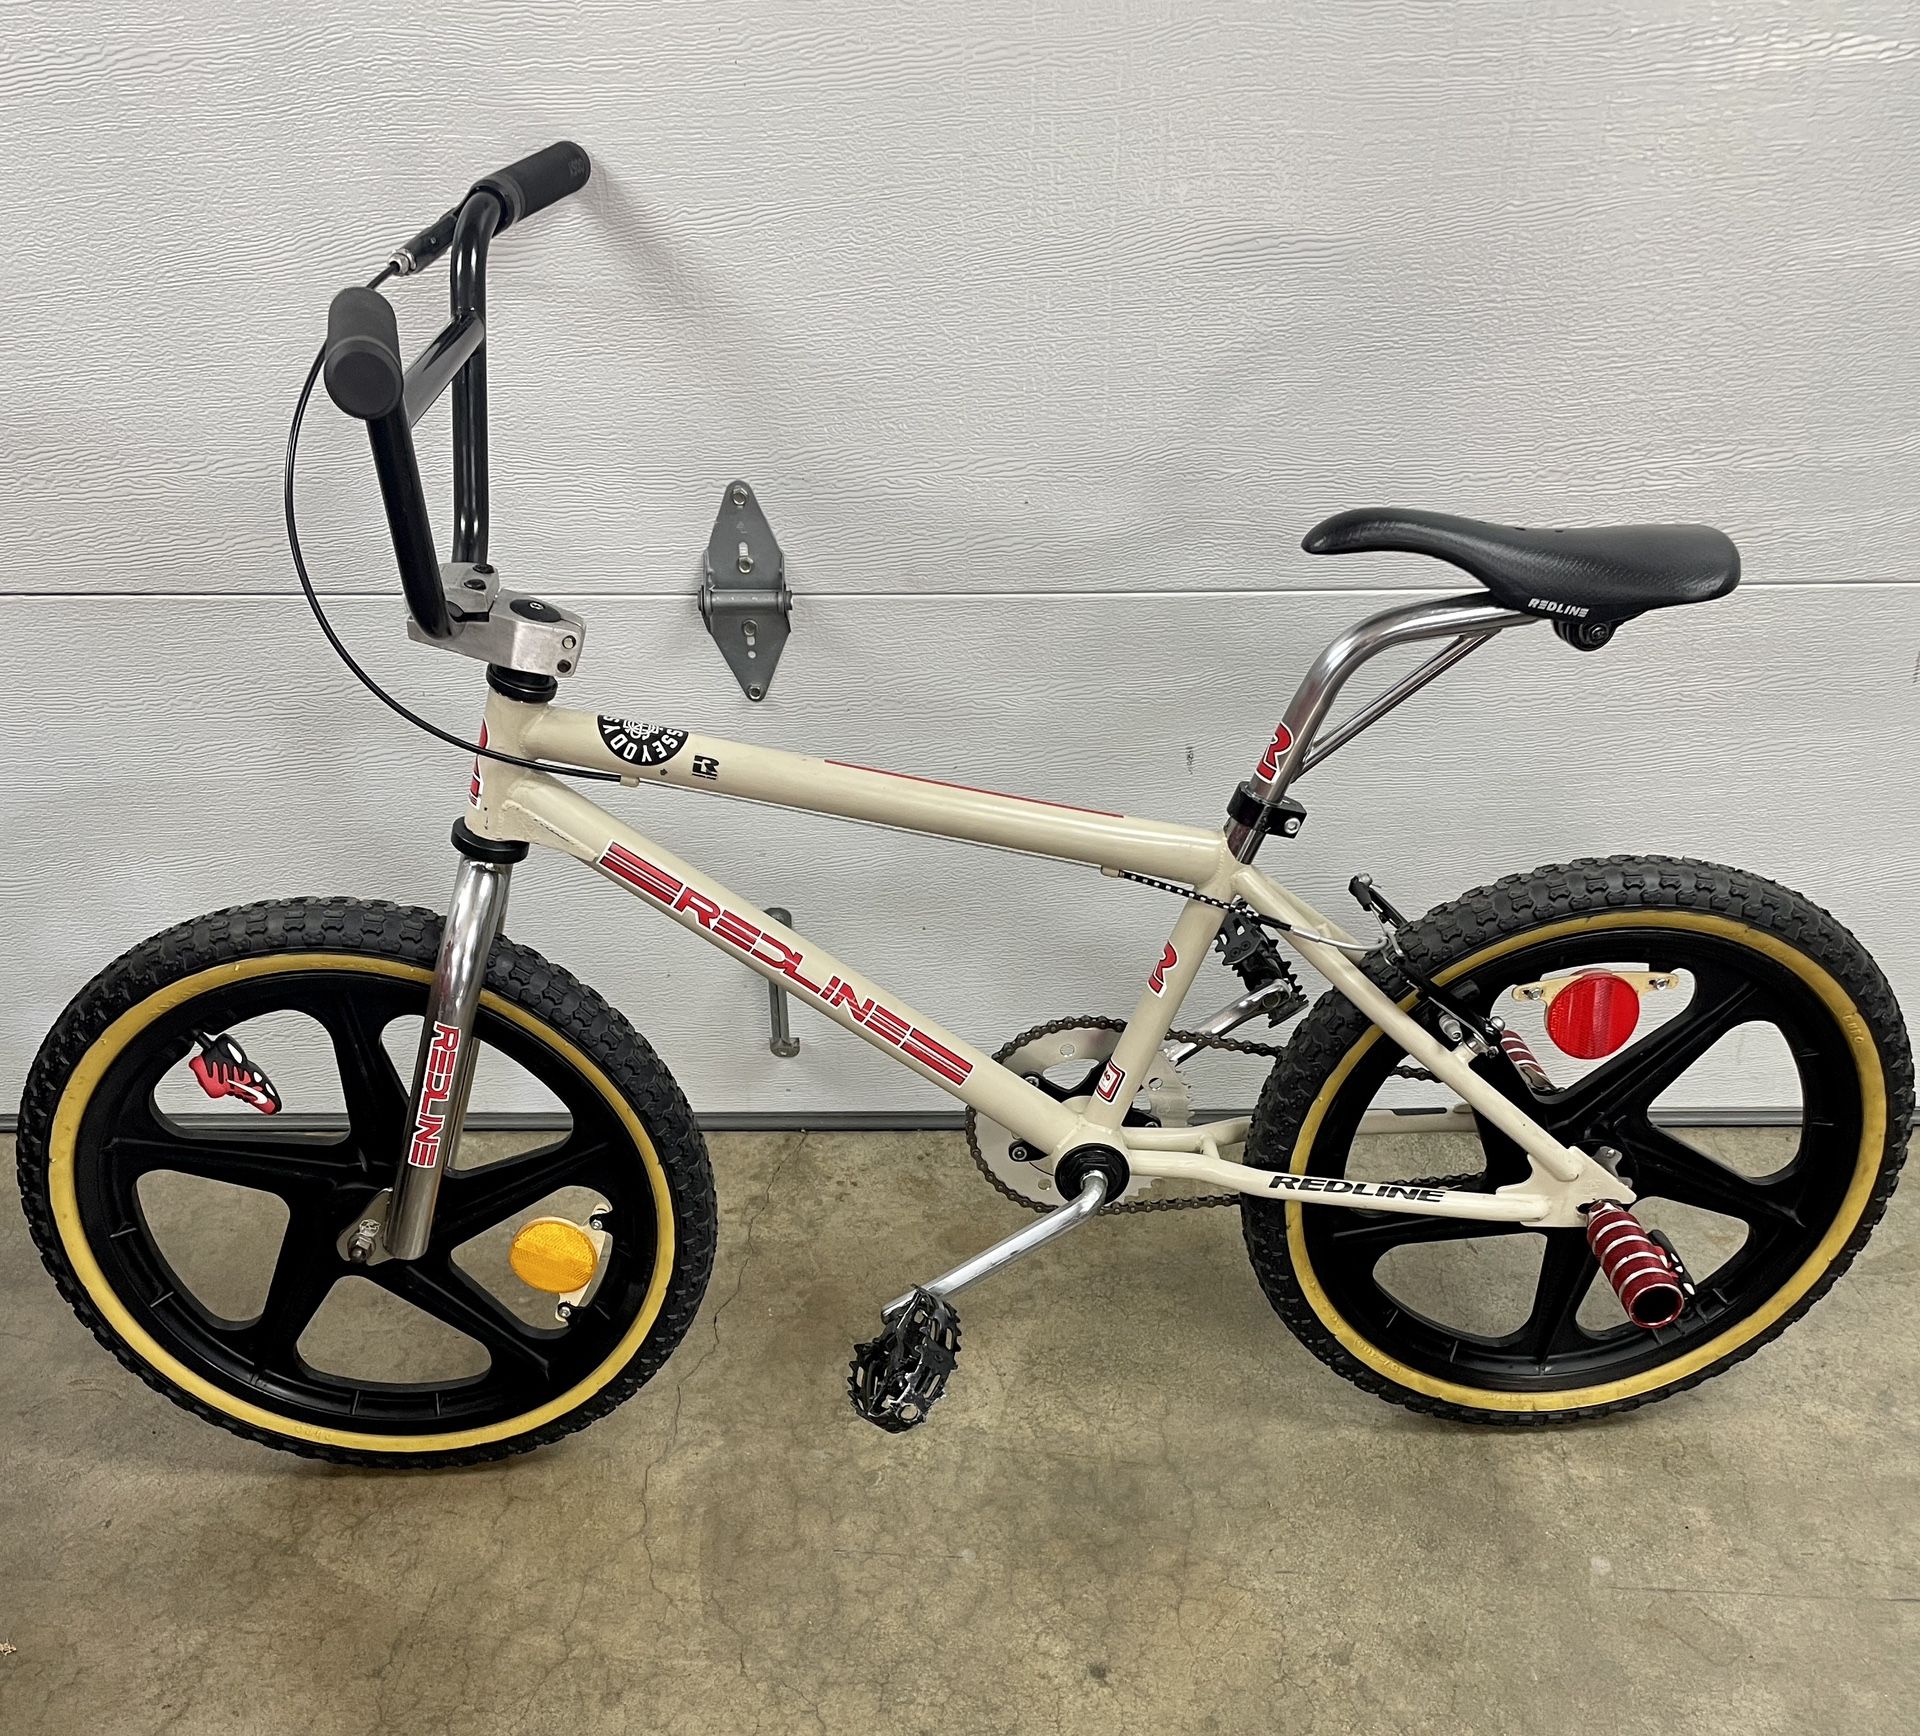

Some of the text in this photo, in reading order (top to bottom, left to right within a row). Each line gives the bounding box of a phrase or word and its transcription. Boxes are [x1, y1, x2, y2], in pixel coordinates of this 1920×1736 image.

[1527, 598, 1590, 618] REDLINE
[673, 884, 912, 1048] REDLINE
[408, 1021, 461, 1168] REDLINE
[1268, 1175, 1446, 1203] REDLINE
